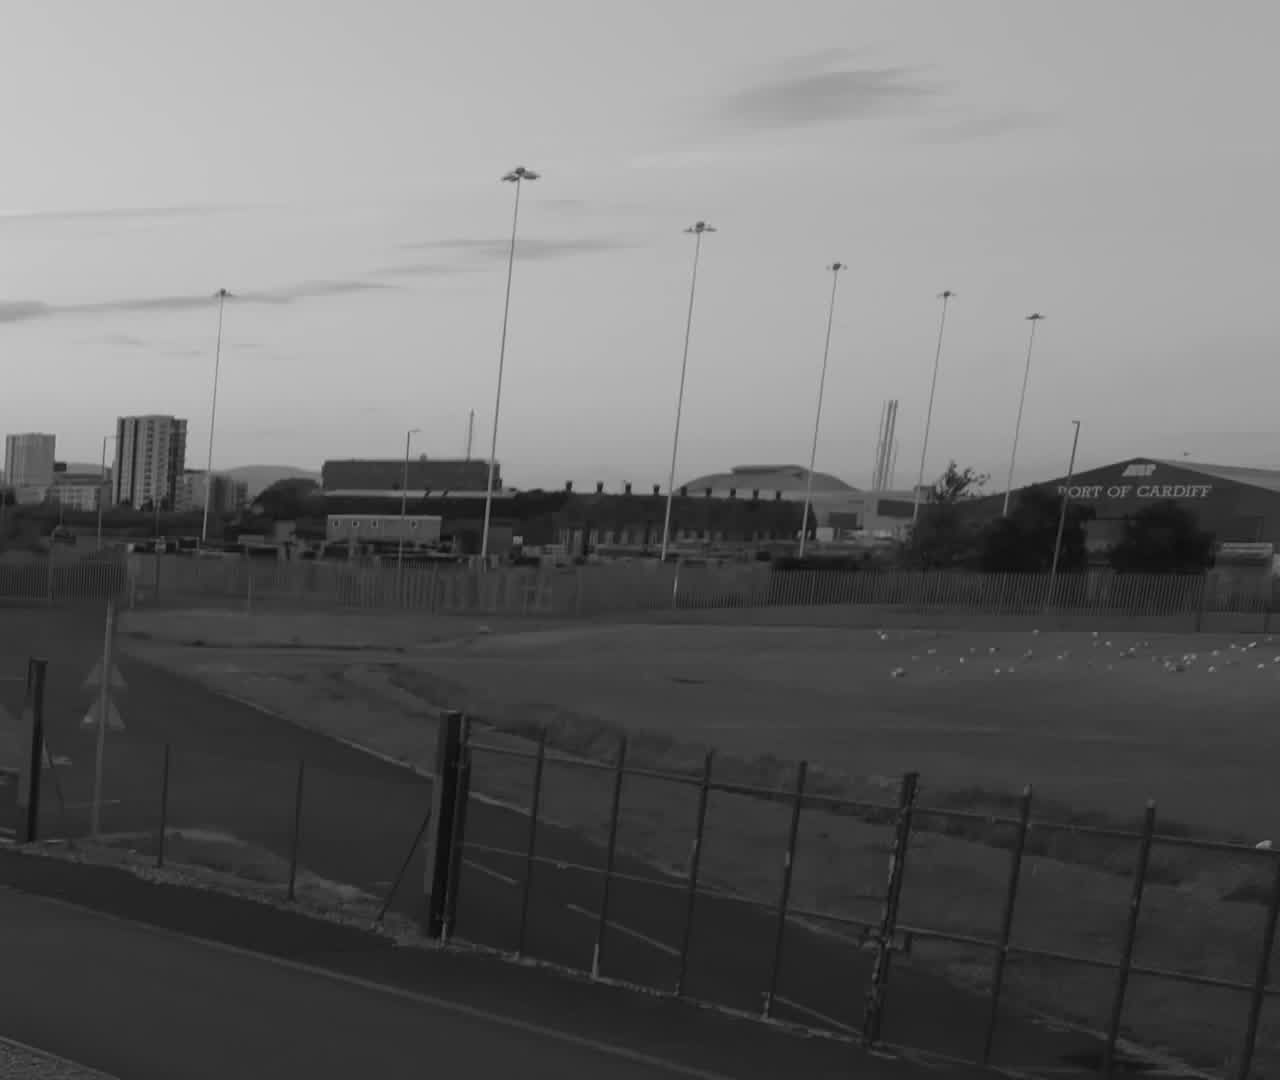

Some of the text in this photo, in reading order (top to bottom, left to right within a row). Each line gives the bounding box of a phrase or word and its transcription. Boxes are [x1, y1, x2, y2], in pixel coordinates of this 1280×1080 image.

[1056, 484, 1213, 498] PORT OF CARDIFF
